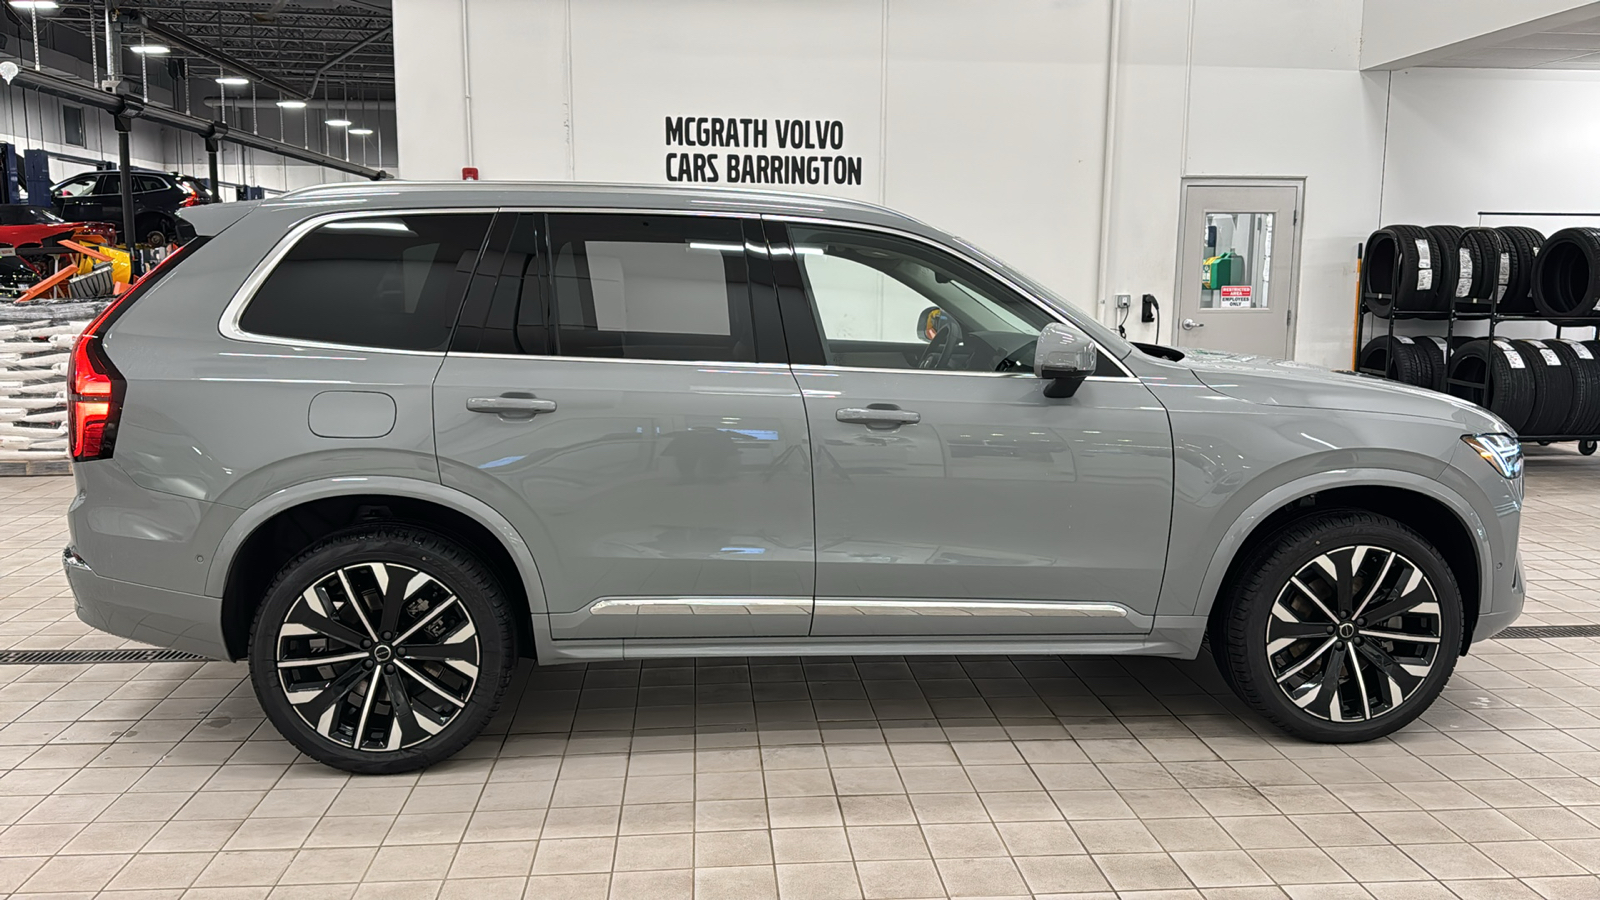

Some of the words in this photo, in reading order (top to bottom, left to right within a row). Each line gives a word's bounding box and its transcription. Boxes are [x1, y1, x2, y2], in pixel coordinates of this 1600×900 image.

[665, 116, 767, 148] MCGRATH
[775, 119, 843, 150] VOLVO
[666, 153, 719, 183] CARS
[727, 154, 862, 185] BARRINGTON
